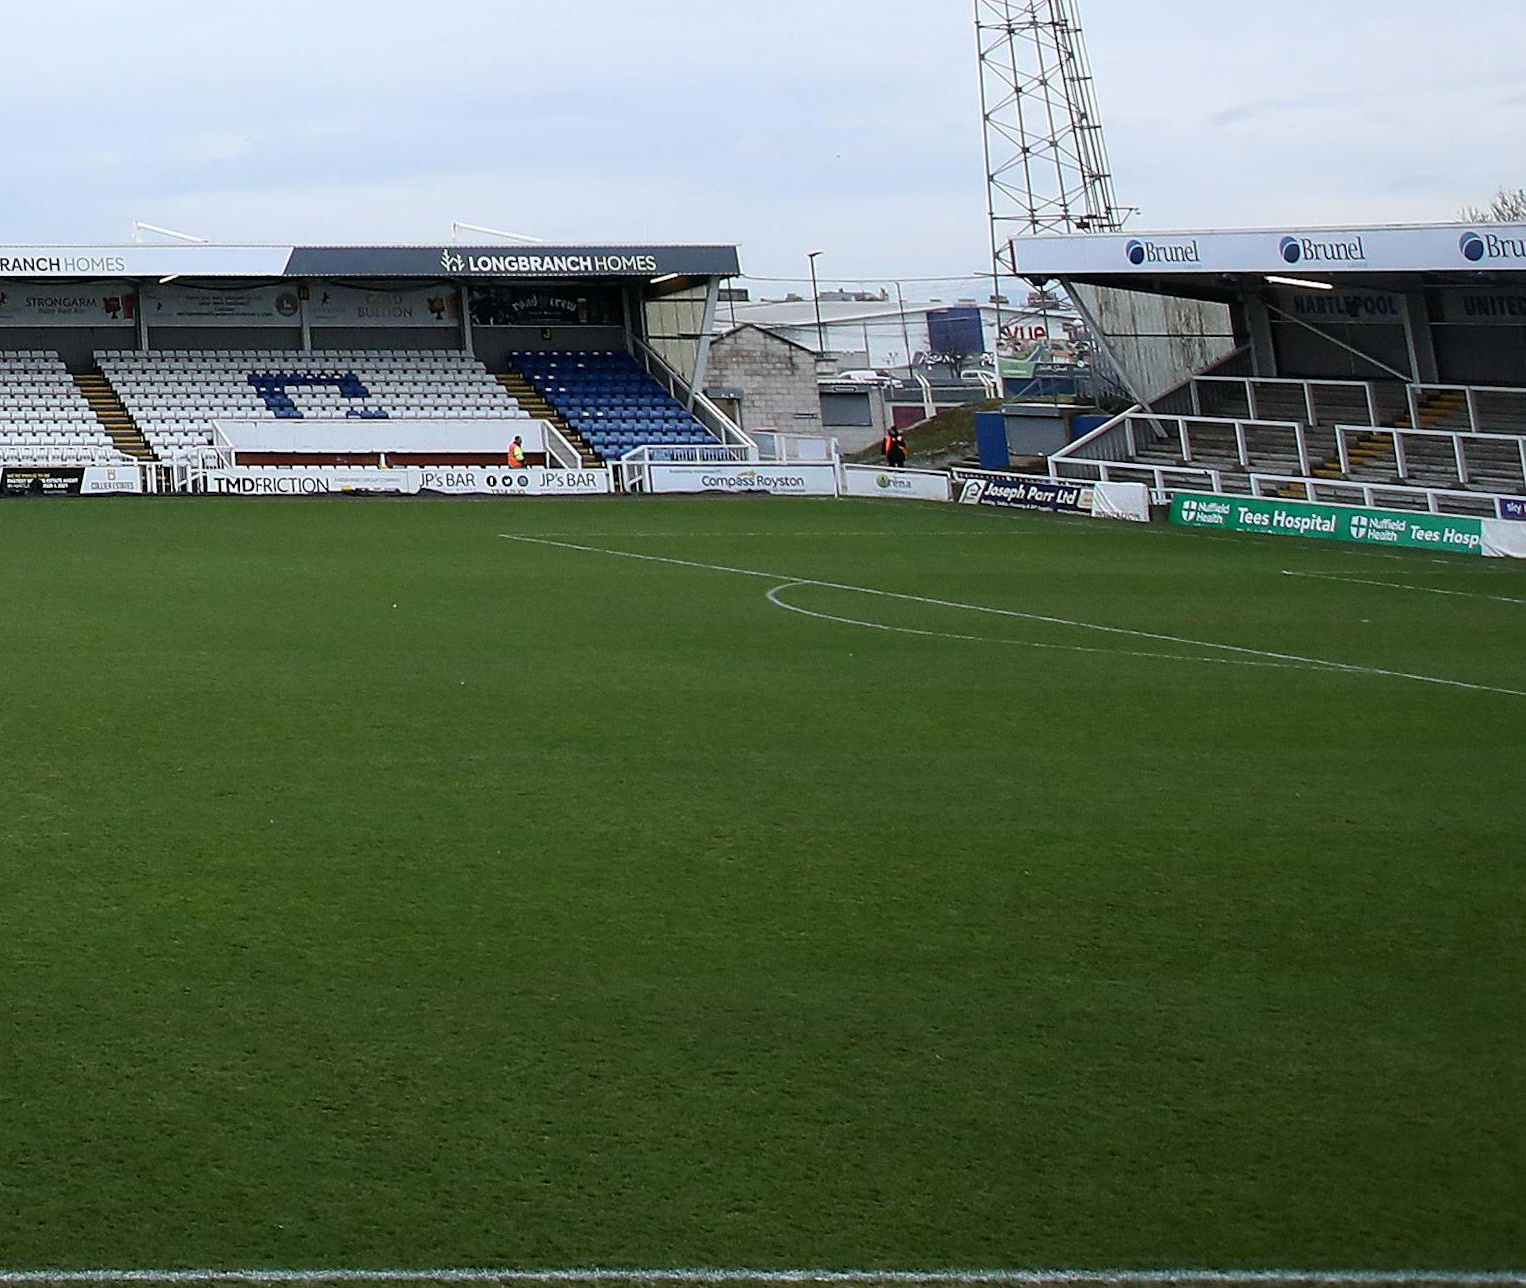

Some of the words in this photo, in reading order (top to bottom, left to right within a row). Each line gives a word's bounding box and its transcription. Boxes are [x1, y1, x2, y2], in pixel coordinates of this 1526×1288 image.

[1146, 240, 1201, 263] Brunel
[1300, 236, 1366, 261] Brunel
[1484, 233, 1526, 258] Bru
[65, 257, 125, 272] HOMES
[468, 256, 592, 272] LONGBRANCH
[594, 256, 657, 272] HOMES
[26, 297, 97, 308] STRONGARM
[512, 296, 538, 311] road
[550, 298, 577, 312] crew
[419, 472, 443, 488] JP's
[446, 473, 476, 486] BAR
[539, 472, 563, 487] JP's
[566, 473, 597, 487] BAR
[701, 475, 755, 489] Compass
[756, 475, 804, 489] Royston
[984, 483, 1025, 501] Joseph
[1027, 487, 1055, 502] Parr
[1056, 489, 1078, 505] Ltd
[1198, 501, 1230, 514] Nuffield
[1506, 502, 1522, 515] sky
[1196, 512, 1223, 524] Health
[1238, 507, 1271, 526] Tees
[1272, 509, 1337, 534] Hospital
[1369, 519, 1406, 532] Nuffield
[1367, 529, 1398, 542] Health
[1410, 524, 1440, 542] Tees
[1442, 528, 1480, 549] Hosp
